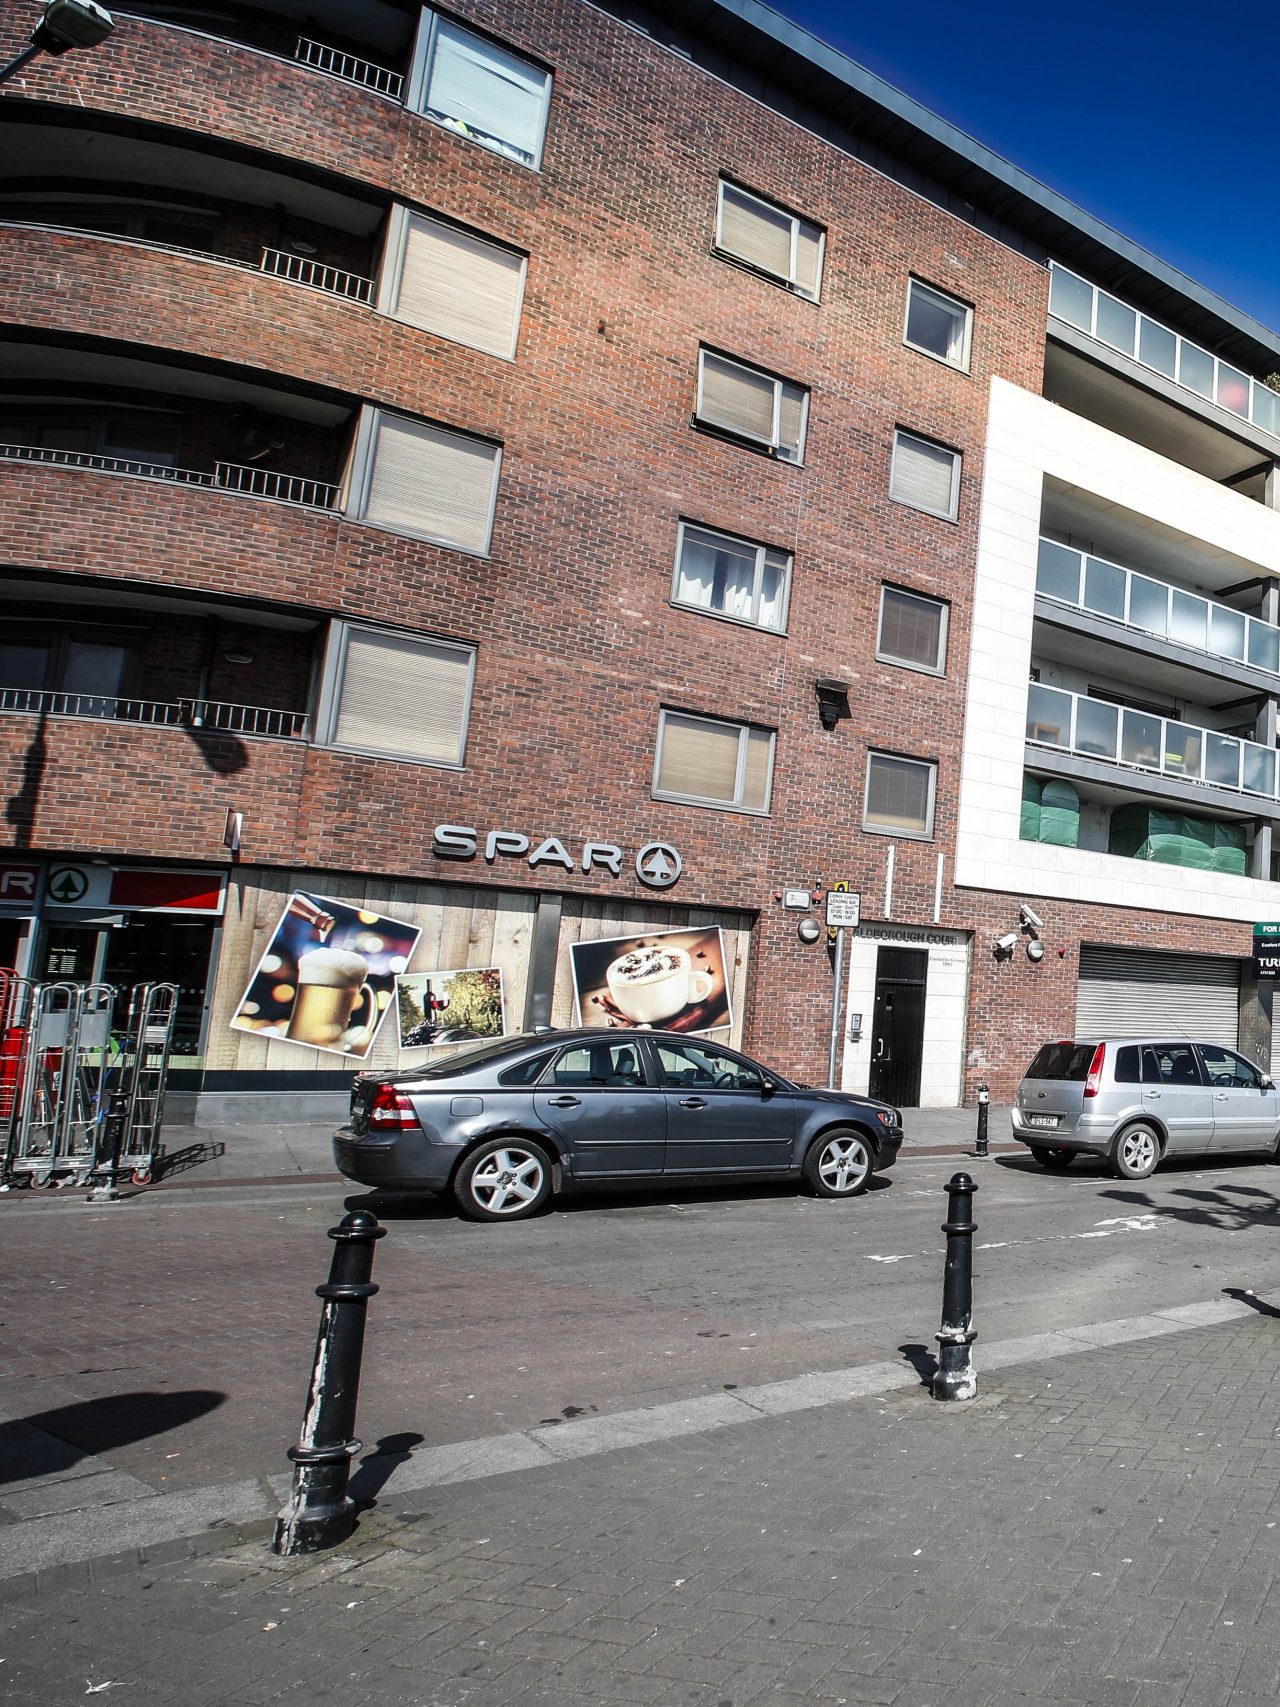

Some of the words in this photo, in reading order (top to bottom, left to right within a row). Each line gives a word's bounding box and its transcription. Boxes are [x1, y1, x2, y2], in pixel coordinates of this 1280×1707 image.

[432, 824, 622, 874] SPAR
[853, 927, 925, 944] ALDBOROUGH
[926, 933, 960, 946] COURT
